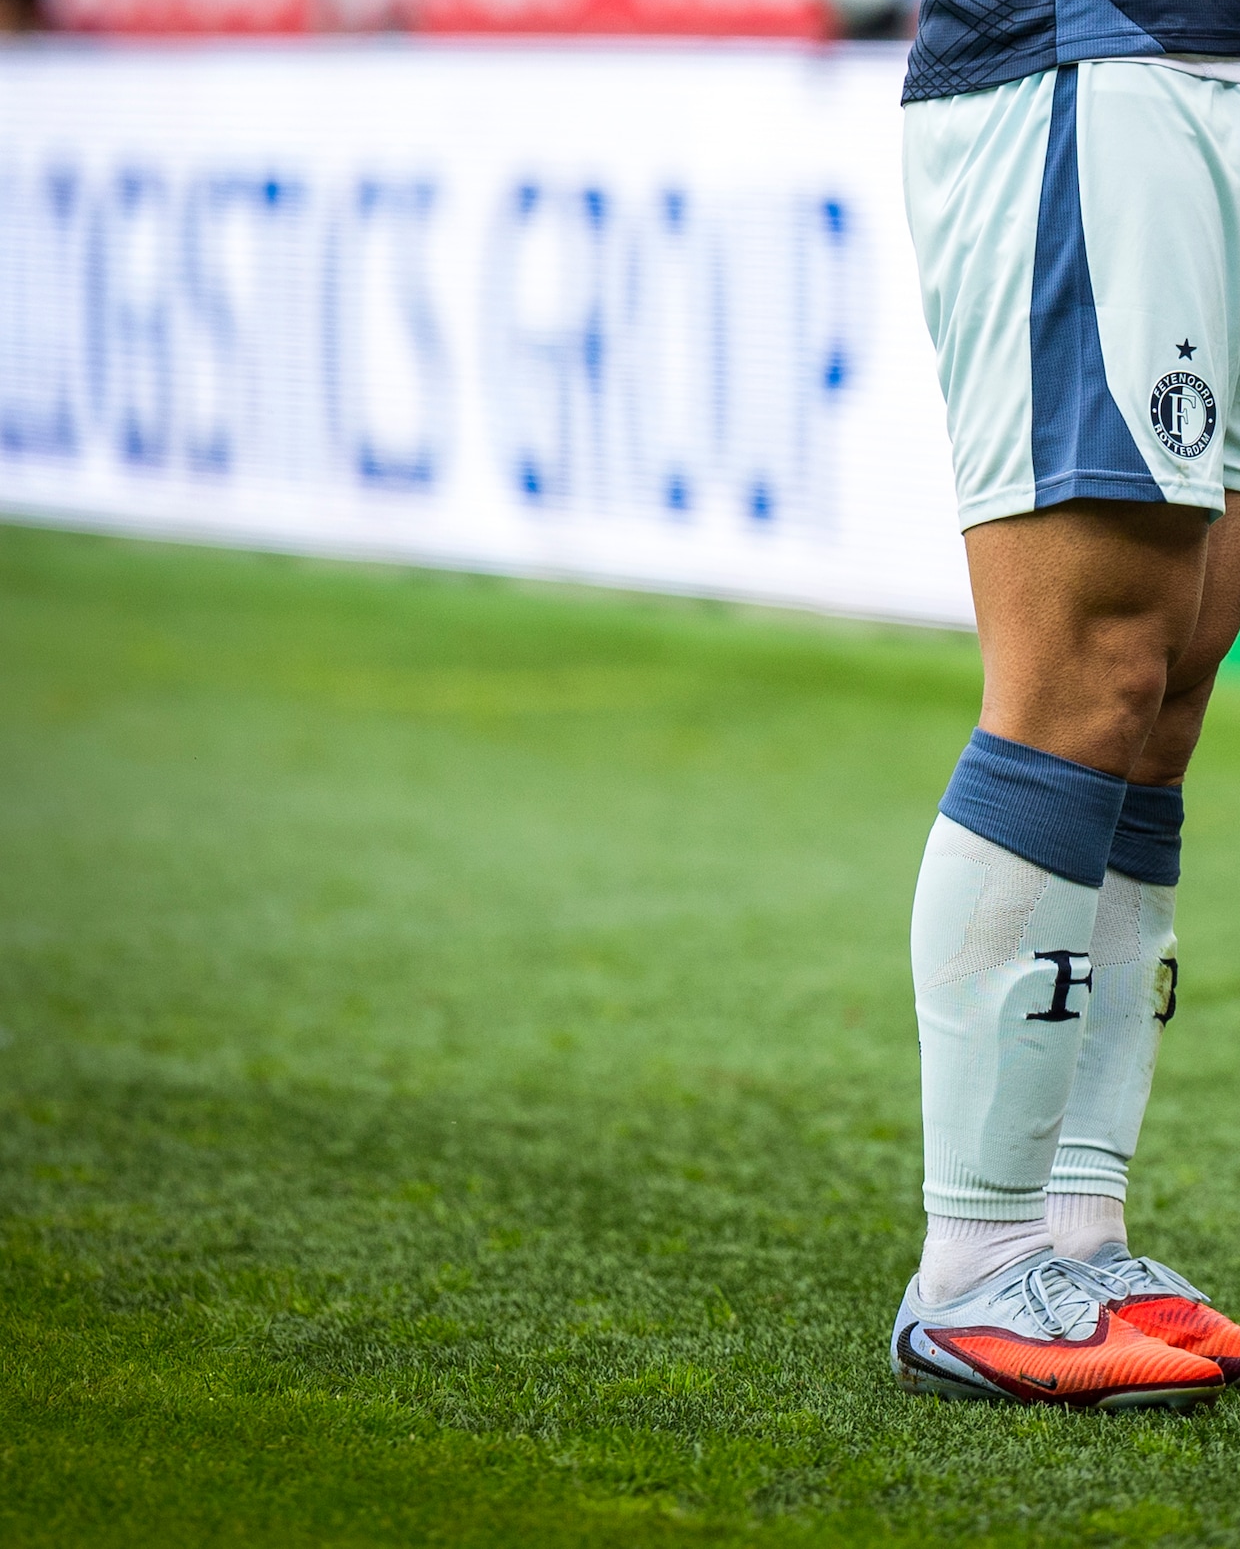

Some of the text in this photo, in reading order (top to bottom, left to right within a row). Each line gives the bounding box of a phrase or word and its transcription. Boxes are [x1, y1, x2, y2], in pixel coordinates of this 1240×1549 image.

[1153, 373, 1214, 408] FEYENOORD
[1169, 392, 1197, 436] F
[1154, 423, 1211, 457] ROTTERDAM
